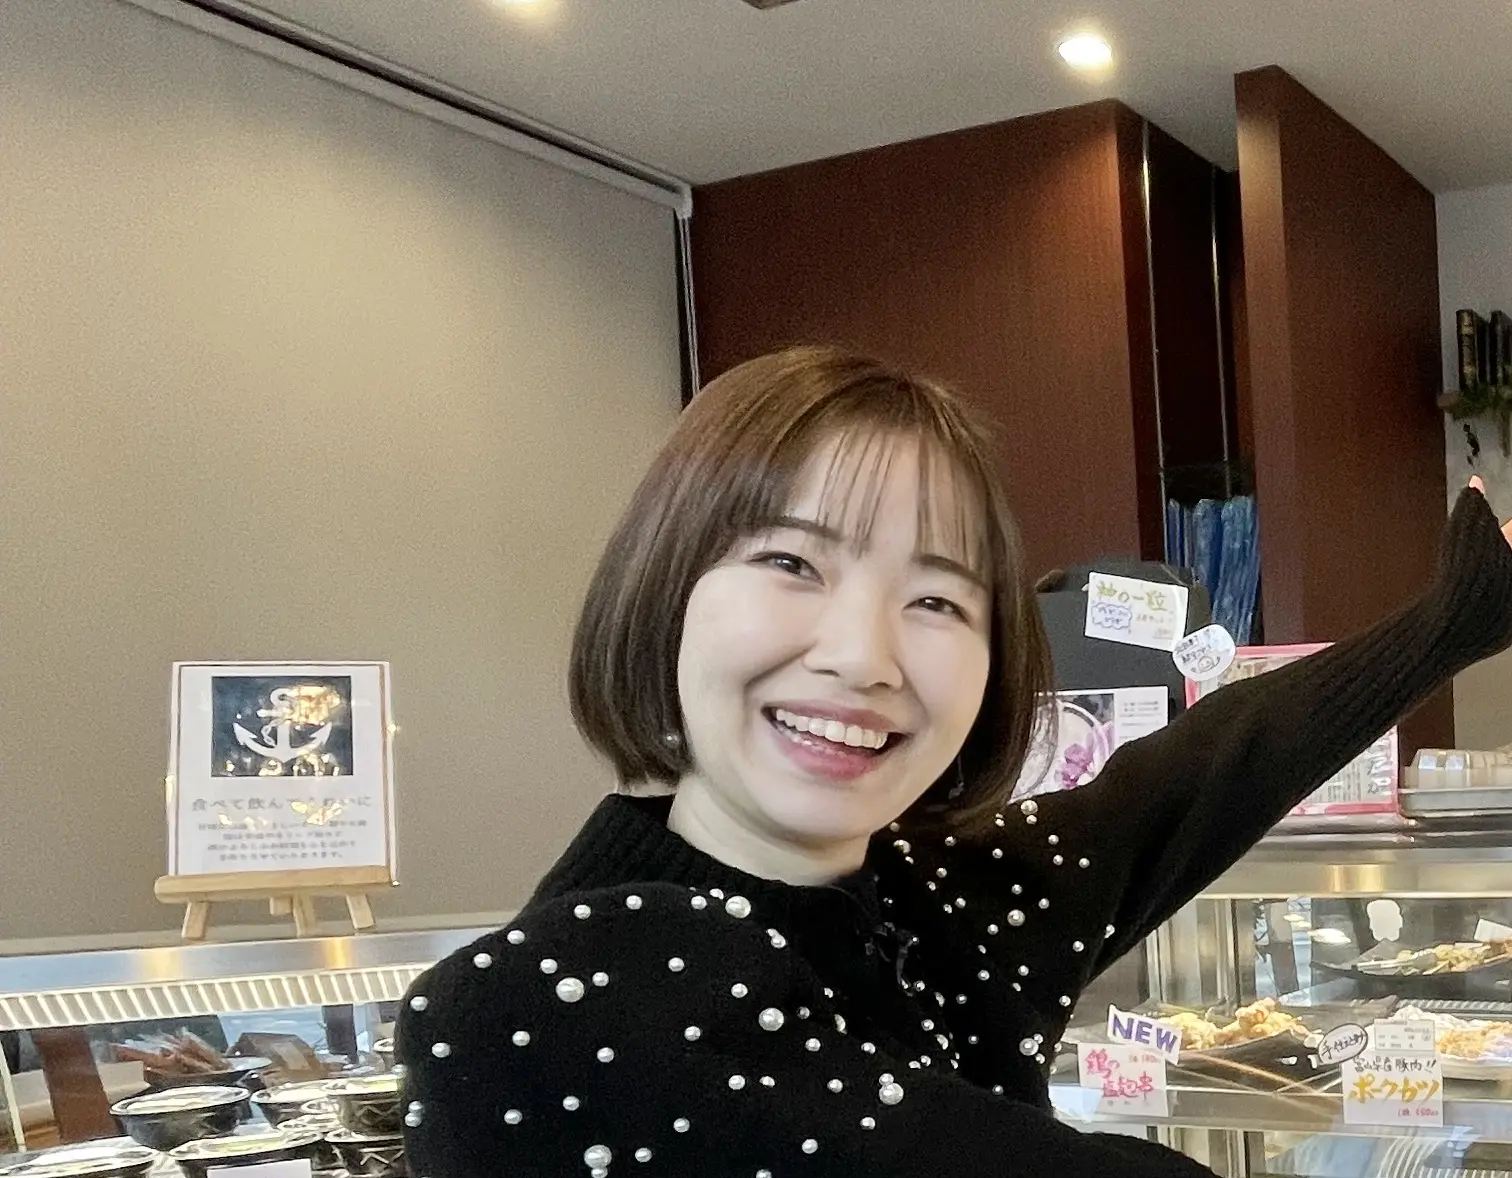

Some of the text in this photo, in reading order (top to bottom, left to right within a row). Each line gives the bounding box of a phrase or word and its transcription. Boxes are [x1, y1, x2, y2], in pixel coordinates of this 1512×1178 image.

[1112, 1013, 1178, 1054] NEW
[1348, 1072, 1440, 1108] ポークカツ
